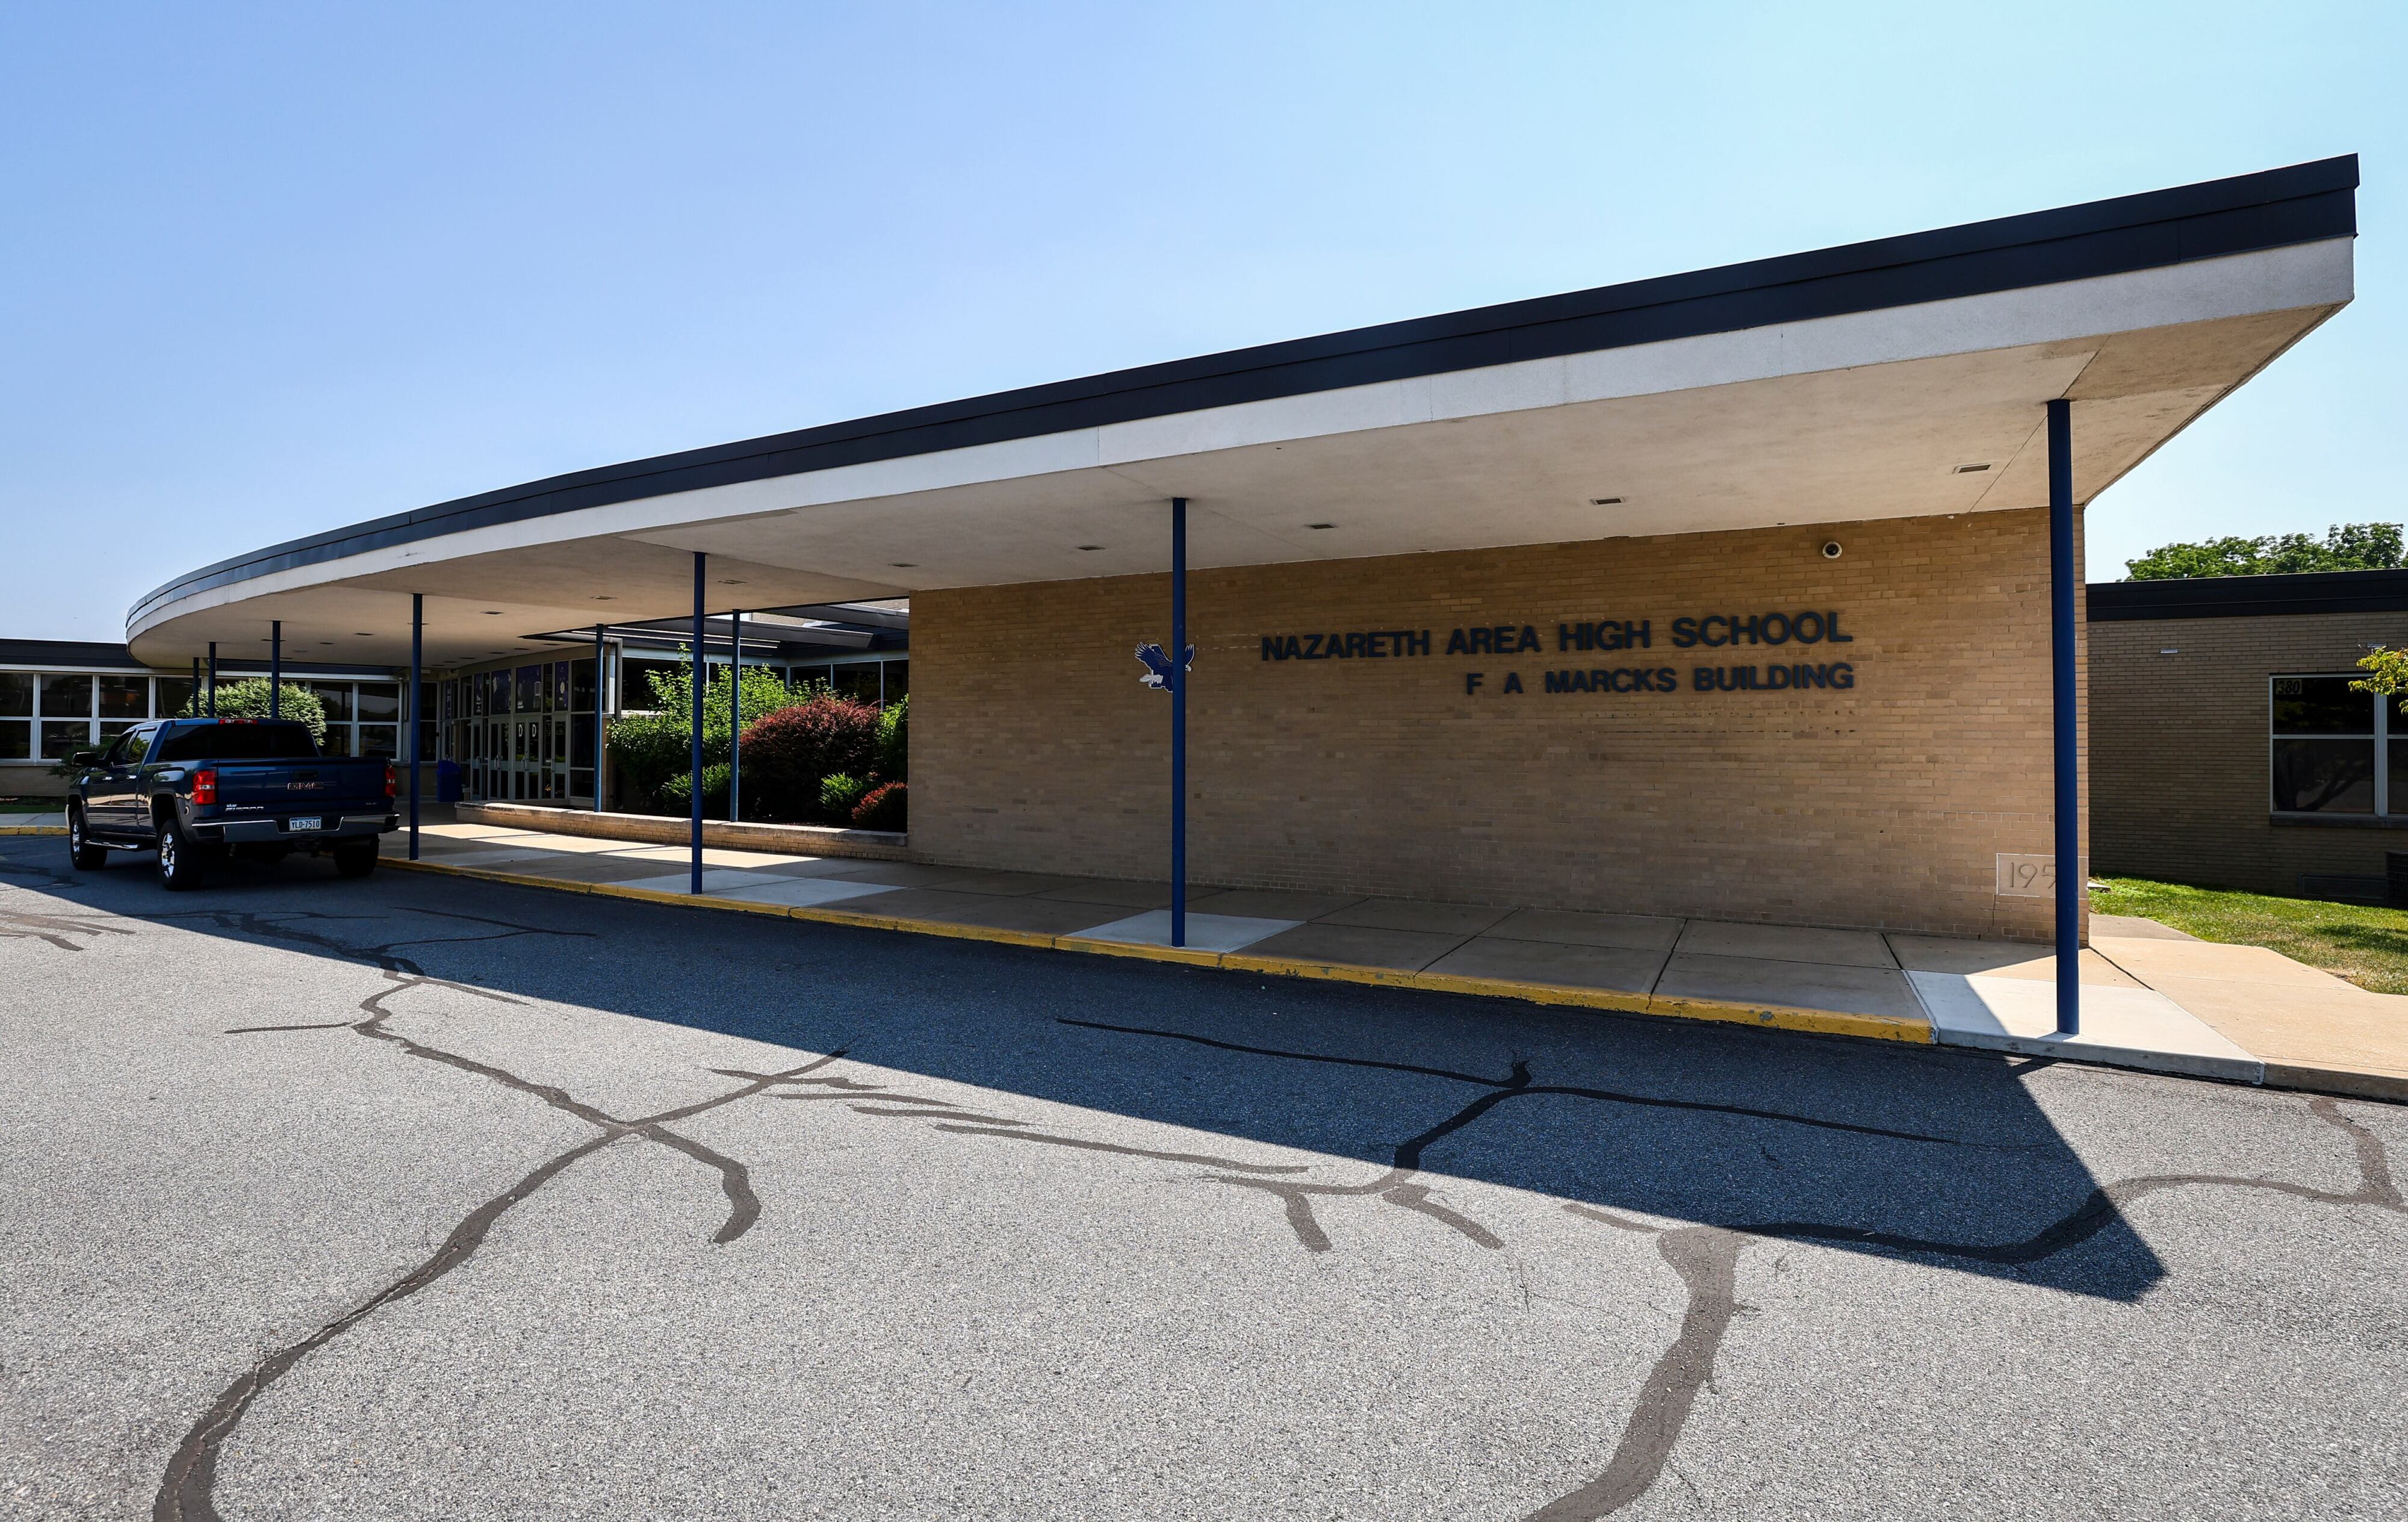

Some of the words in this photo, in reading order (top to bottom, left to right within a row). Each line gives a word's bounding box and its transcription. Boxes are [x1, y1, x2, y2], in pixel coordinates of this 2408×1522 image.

[1262, 630, 1429, 660] NAZARETH
[1447, 625, 1541, 655] AREA
[1559, 620, 1651, 651] HIGH
[1672, 611, 1854, 648] SCHOOL
[1466, 672, 1483, 695] F
[1504, 672, 1524, 694] A
[1545, 667, 1677, 693] MARCKS
[1694, 663, 1854, 691] BUILDING
[2277, 680, 2300, 694] 380
[291, 820, 320, 828] YLD-7510
[2009, 862, 2056, 889] 195
